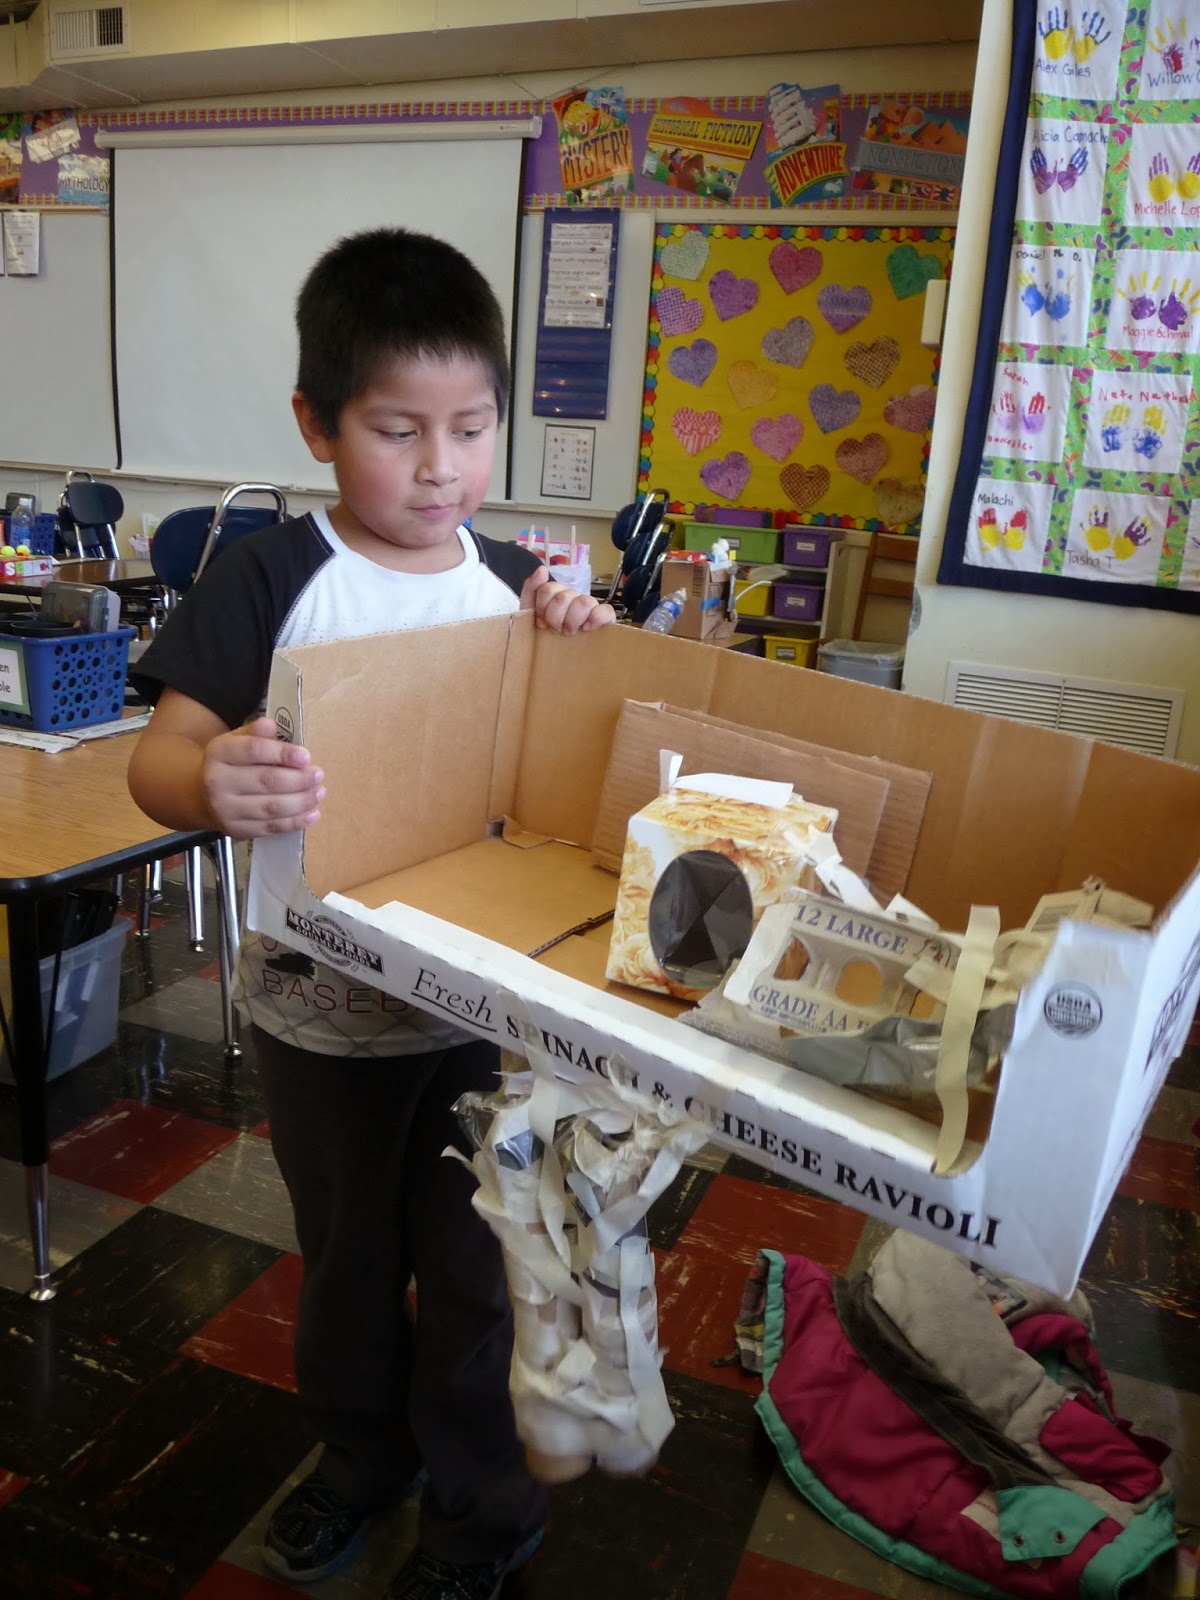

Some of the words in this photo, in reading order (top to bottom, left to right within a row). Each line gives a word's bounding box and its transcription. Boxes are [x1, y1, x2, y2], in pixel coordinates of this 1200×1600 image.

[1035, 58, 1057, 74] Alex
[1062, 62, 1091, 77] Giles
[1147, 71, 1193, 87] Willow
[652, 118, 701, 137] HISTORICAL
[702, 121, 757, 146] FICTION
[562, 128, 629, 184] MYSTERY
[59, 176, 110, 191] MYTHOLOGY
[774, 143, 844, 200] ADVENTURE
[1134, 200, 1177, 215] Michelle
[977, 493, 1014, 506] Malachi
[288, 908, 381, 965] MONTEREY
[794, 904, 822, 926] 12
[825, 914, 911, 954] LARGE
[752, 984, 821, 1020] GRADE
[822, 1009, 848, 1032] AA
[1057, 994, 1091, 1014] USDA
[413, 967, 495, 1023] Fresh
[652, 1081, 673, 1108] &
[835, 1160, 1001, 1248] RAVIOLI
